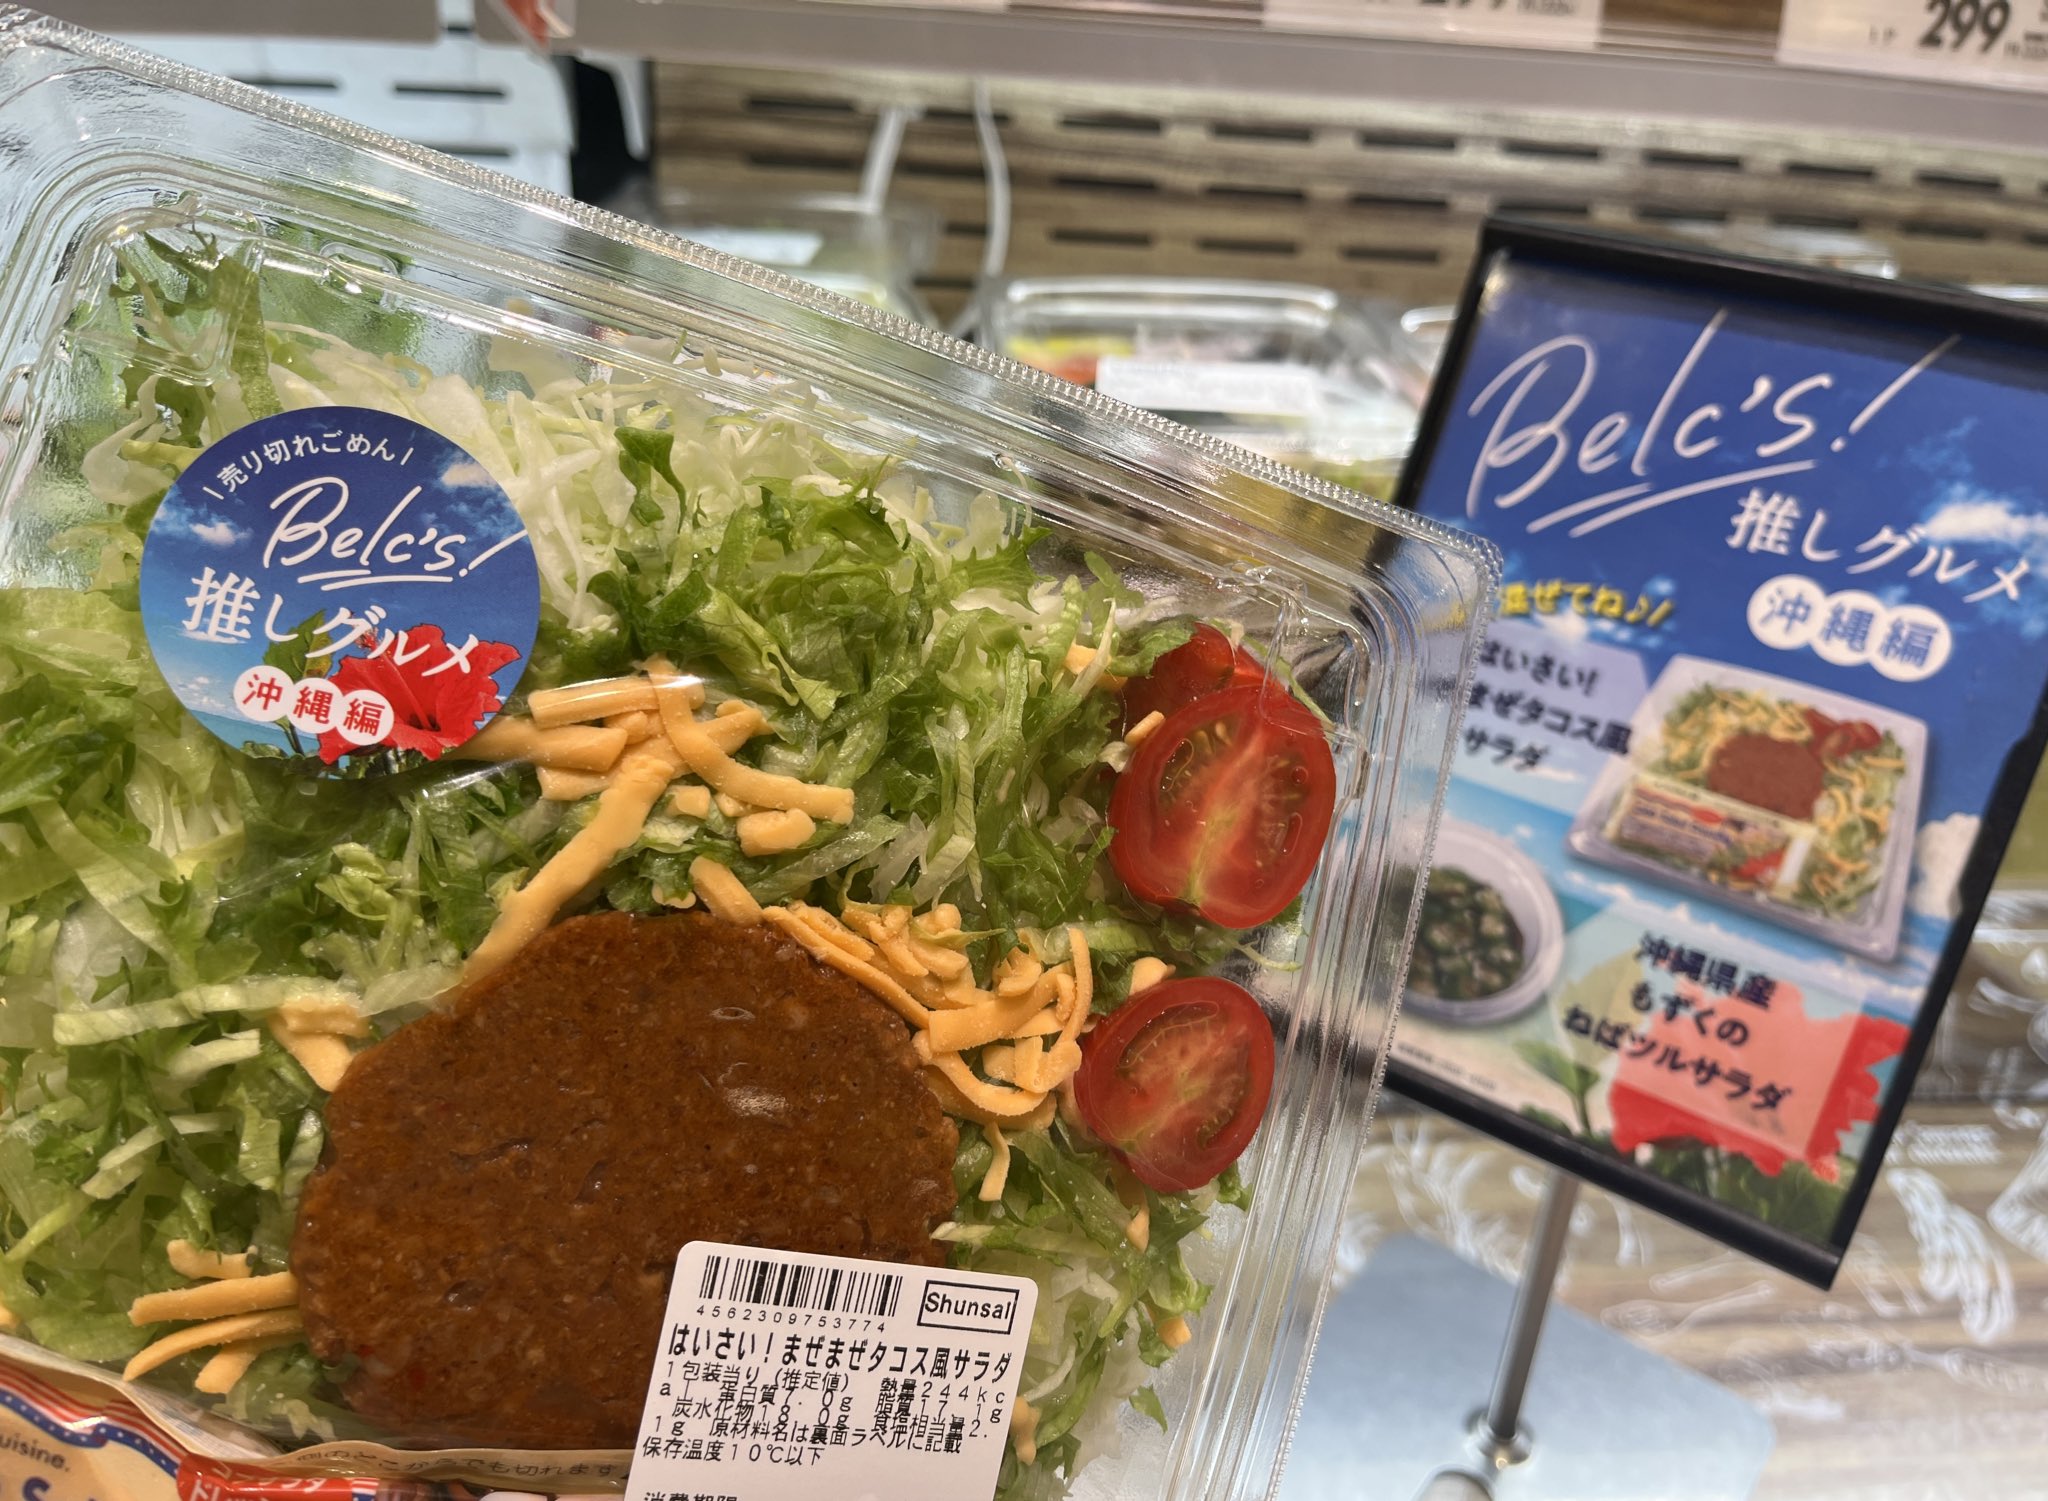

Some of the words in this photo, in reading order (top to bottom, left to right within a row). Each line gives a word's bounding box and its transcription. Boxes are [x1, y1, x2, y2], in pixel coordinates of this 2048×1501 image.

[1919, 0, 2012, 54] 299
[1466, 309, 1960, 518] Belc's!
[216, 429, 396, 493] 売り切れごめん
[263, 476, 529, 578] Belc's!
[1726, 487, 2031, 604] 推しグルメ
[184, 566, 479, 677] 推しグルメ
[1757, 586, 1939, 669] 沖縄編
[243, 673, 386, 737] 沖縄編
[1463, 722, 1550, 772] サラダ
[1632, 931, 1779, 1011] 沖縄県産
[1630, 980, 1750, 1047] もずくの
[1563, 1003, 1795, 1110] ねばツルサラダ
[696, 1304, 886, 1333] 4562309753774
[668, 1322, 1013, 1384] はいさい！まぜまぜタコス風サラダ
[642, 1435, 826, 1466] 保存温度10℃以下
